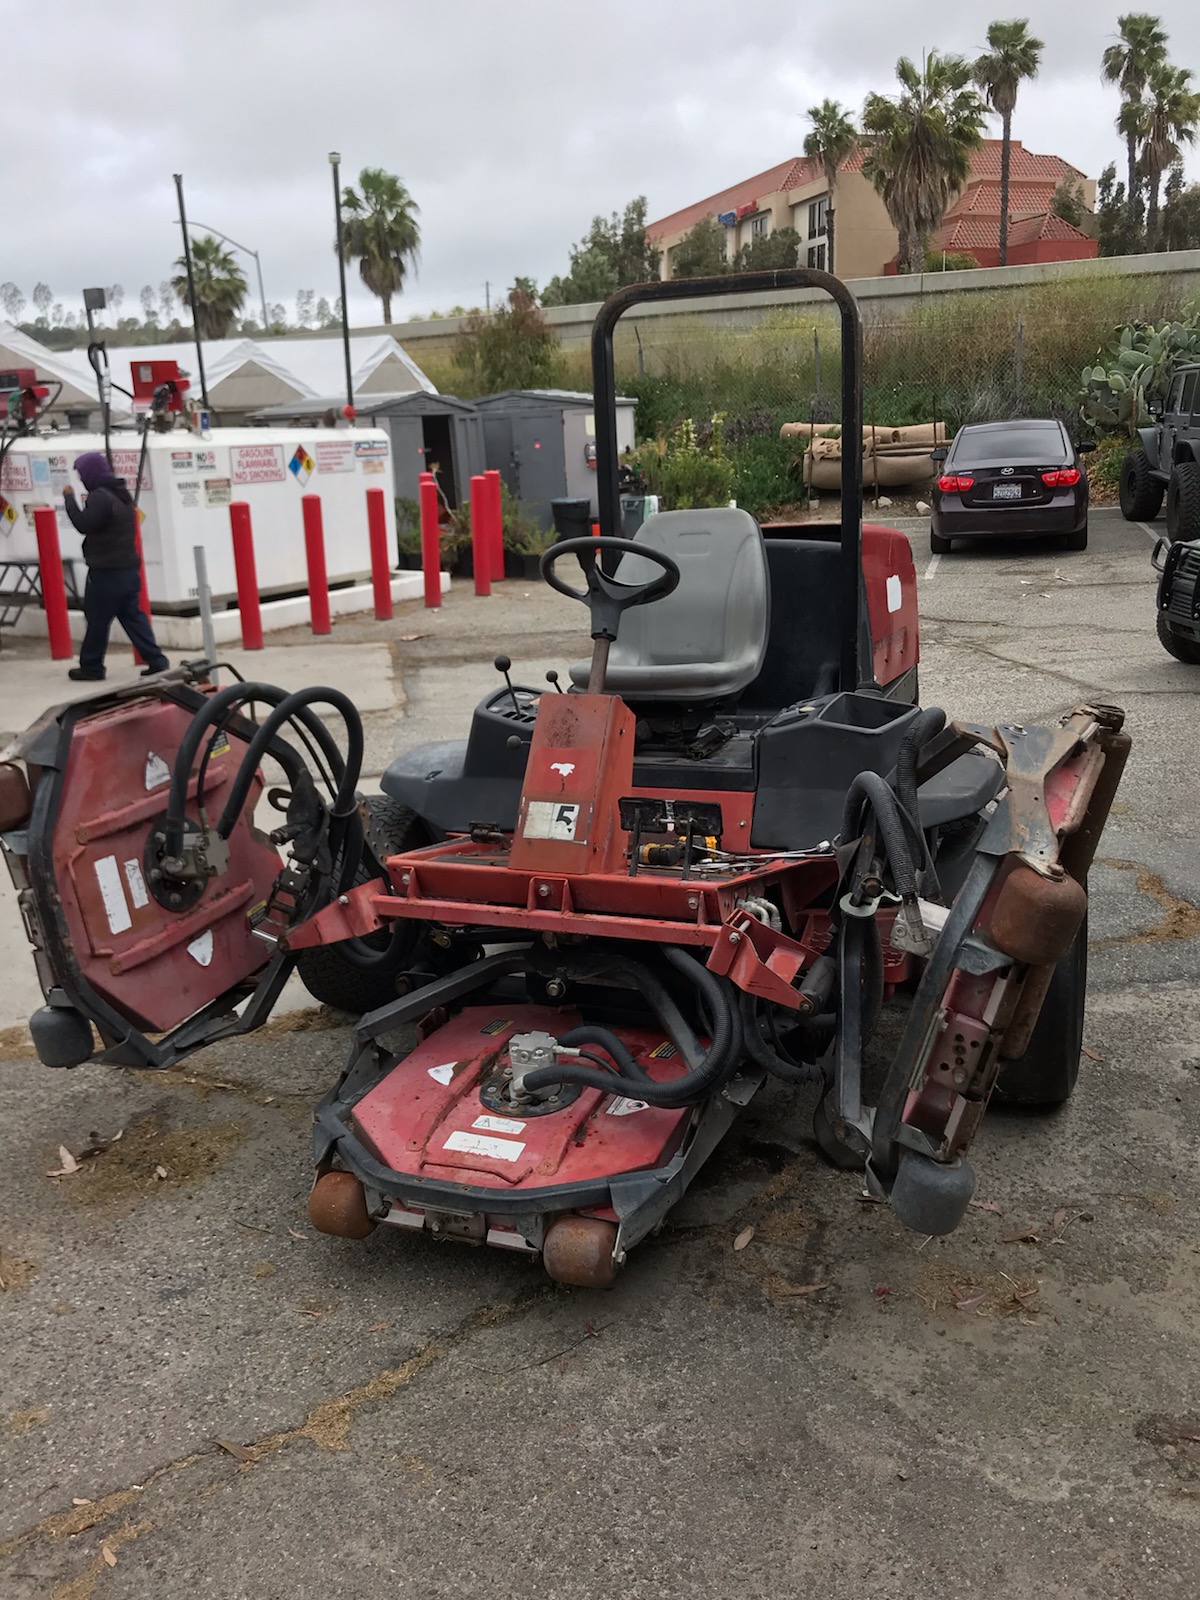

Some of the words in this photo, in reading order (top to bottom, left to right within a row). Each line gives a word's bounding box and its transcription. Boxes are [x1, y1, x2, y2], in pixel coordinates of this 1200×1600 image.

[239, 449, 275, 459] GASOLINE
[237, 459, 278, 470] FLAMMABLE
[235, 471, 248, 482] NO
[249, 469, 283, 480] SMOKING
[556, 805, 575, 826] 5
